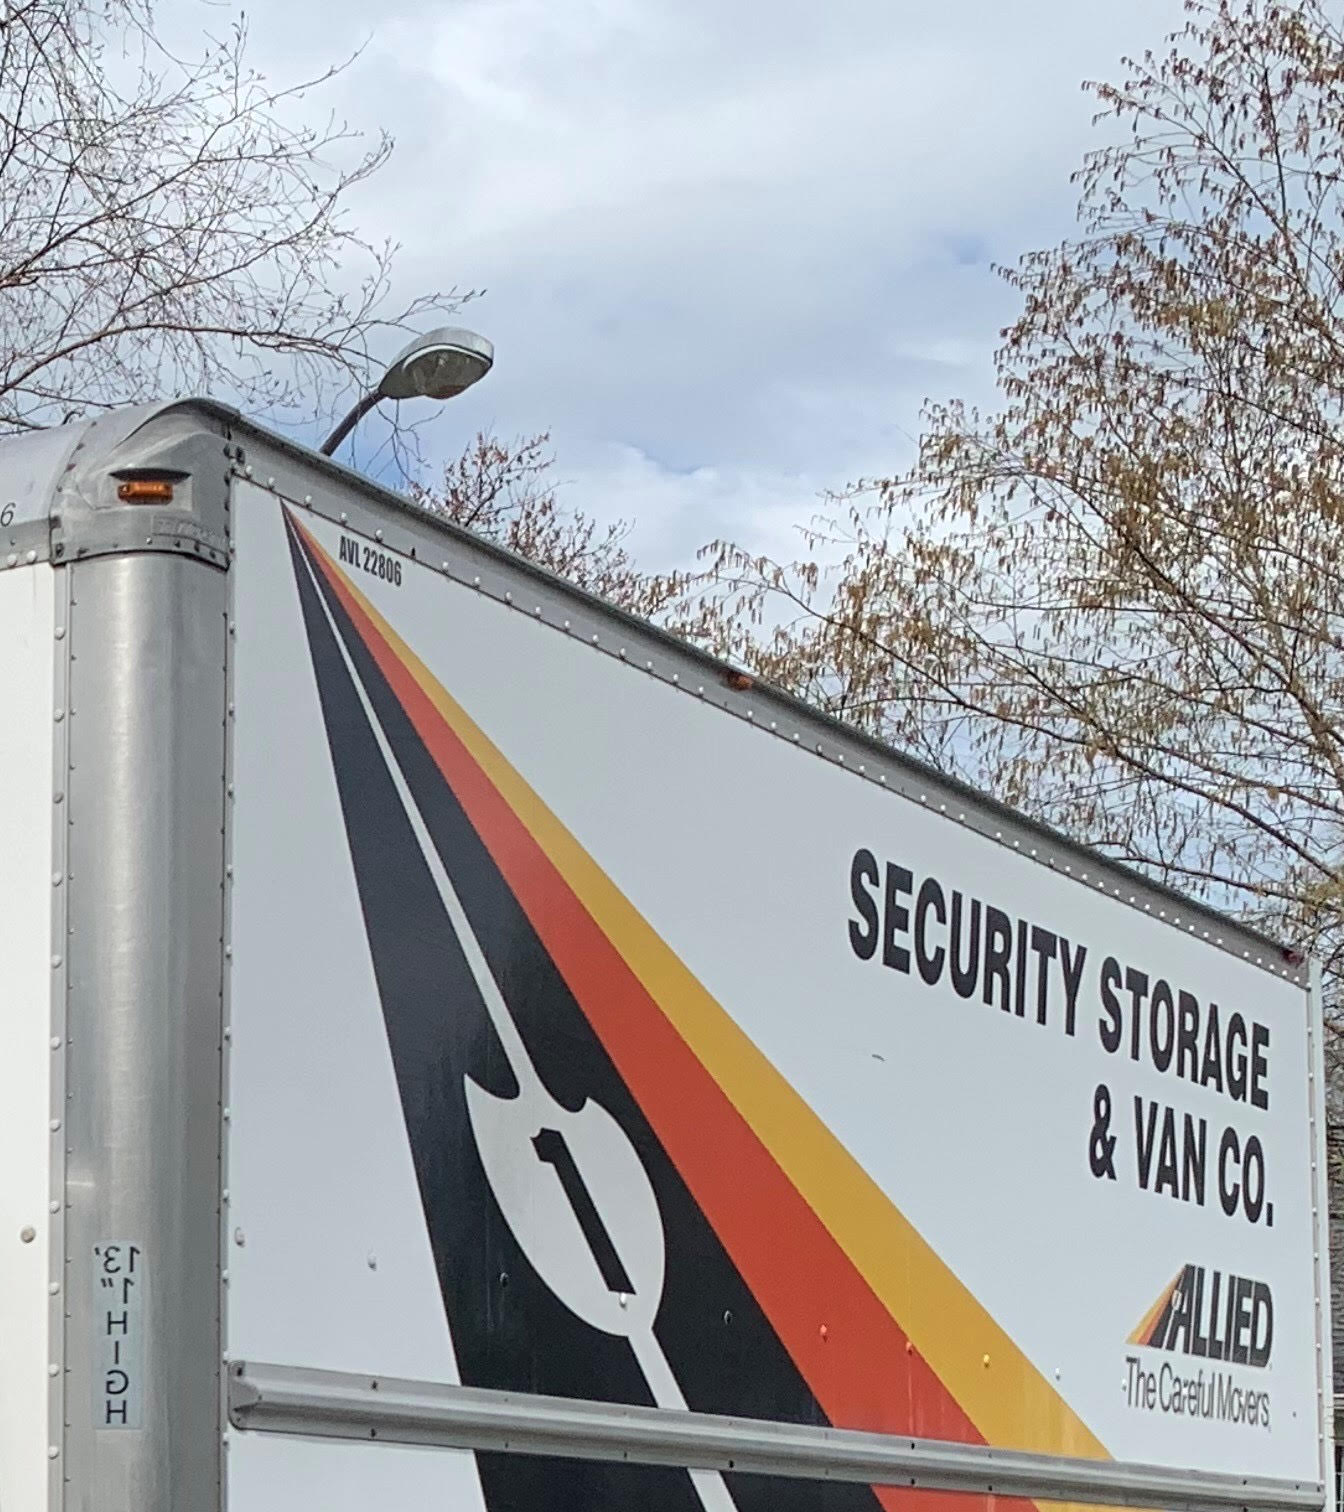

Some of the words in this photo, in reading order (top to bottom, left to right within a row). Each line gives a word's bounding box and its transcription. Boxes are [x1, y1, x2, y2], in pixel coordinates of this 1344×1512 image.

[339, 535, 360, 568] AVL
[363, 546, 402, 587] 22806
[848, 848, 1087, 1037] SECURITY
[1099, 956, 1270, 1111] STORAGE
[1089, 1083, 1117, 1181] &
[1134, 1095, 1207, 1207] VAN
[1218, 1126, 1274, 1228] CO.
[1148, 1263, 1273, 1368] ALLIED
[1126, 1356, 1157, 1410] The
[1159, 1362, 1215, 1419] Careful
[1216, 1372, 1270, 1428] Movers
